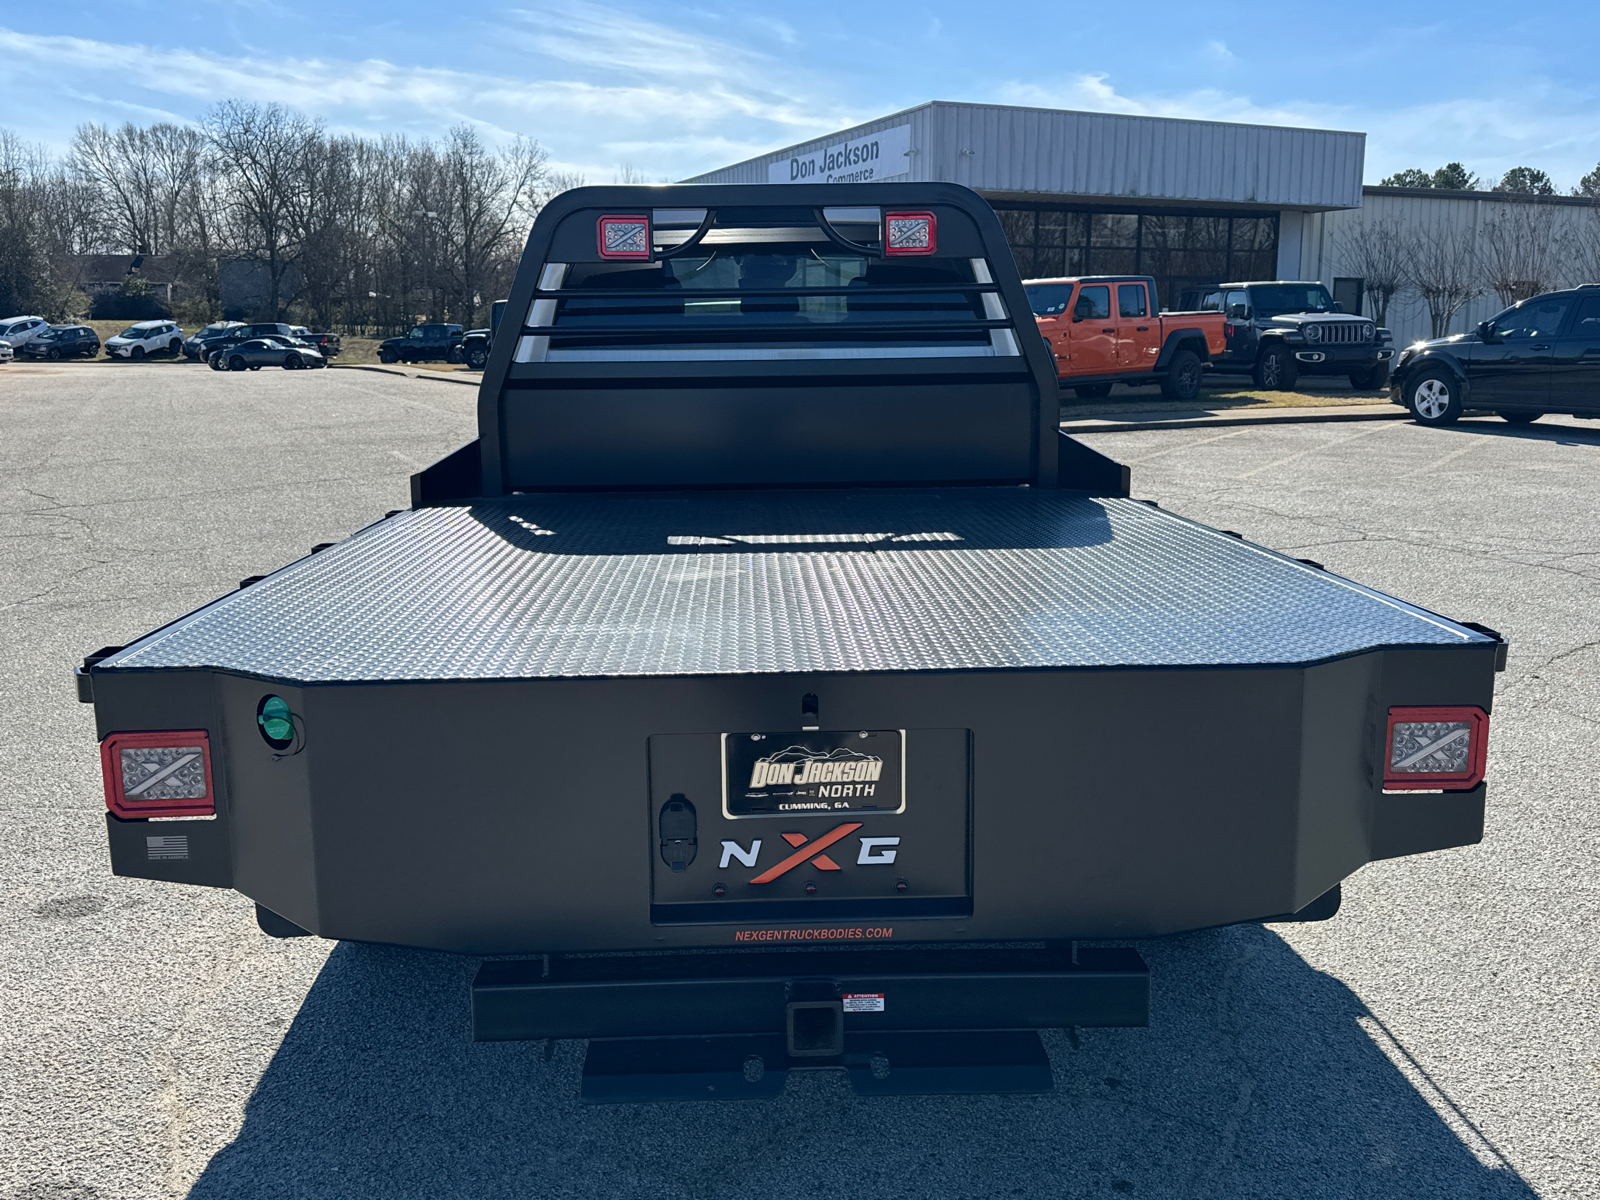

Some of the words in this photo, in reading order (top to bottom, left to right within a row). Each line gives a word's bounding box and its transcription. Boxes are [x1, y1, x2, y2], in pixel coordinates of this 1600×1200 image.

[790, 158, 815, 181] Don
[819, 141, 879, 173] Jackson
[750, 761, 795, 788] DON
[793, 760, 883, 784] JACKSON
[818, 784, 875, 798] NORTH
[779, 802, 831, 810] CUMMING,
[834, 801, 850, 809] GA
[735, 928, 893, 941] NEXGENTRUCKBODIES.COM
